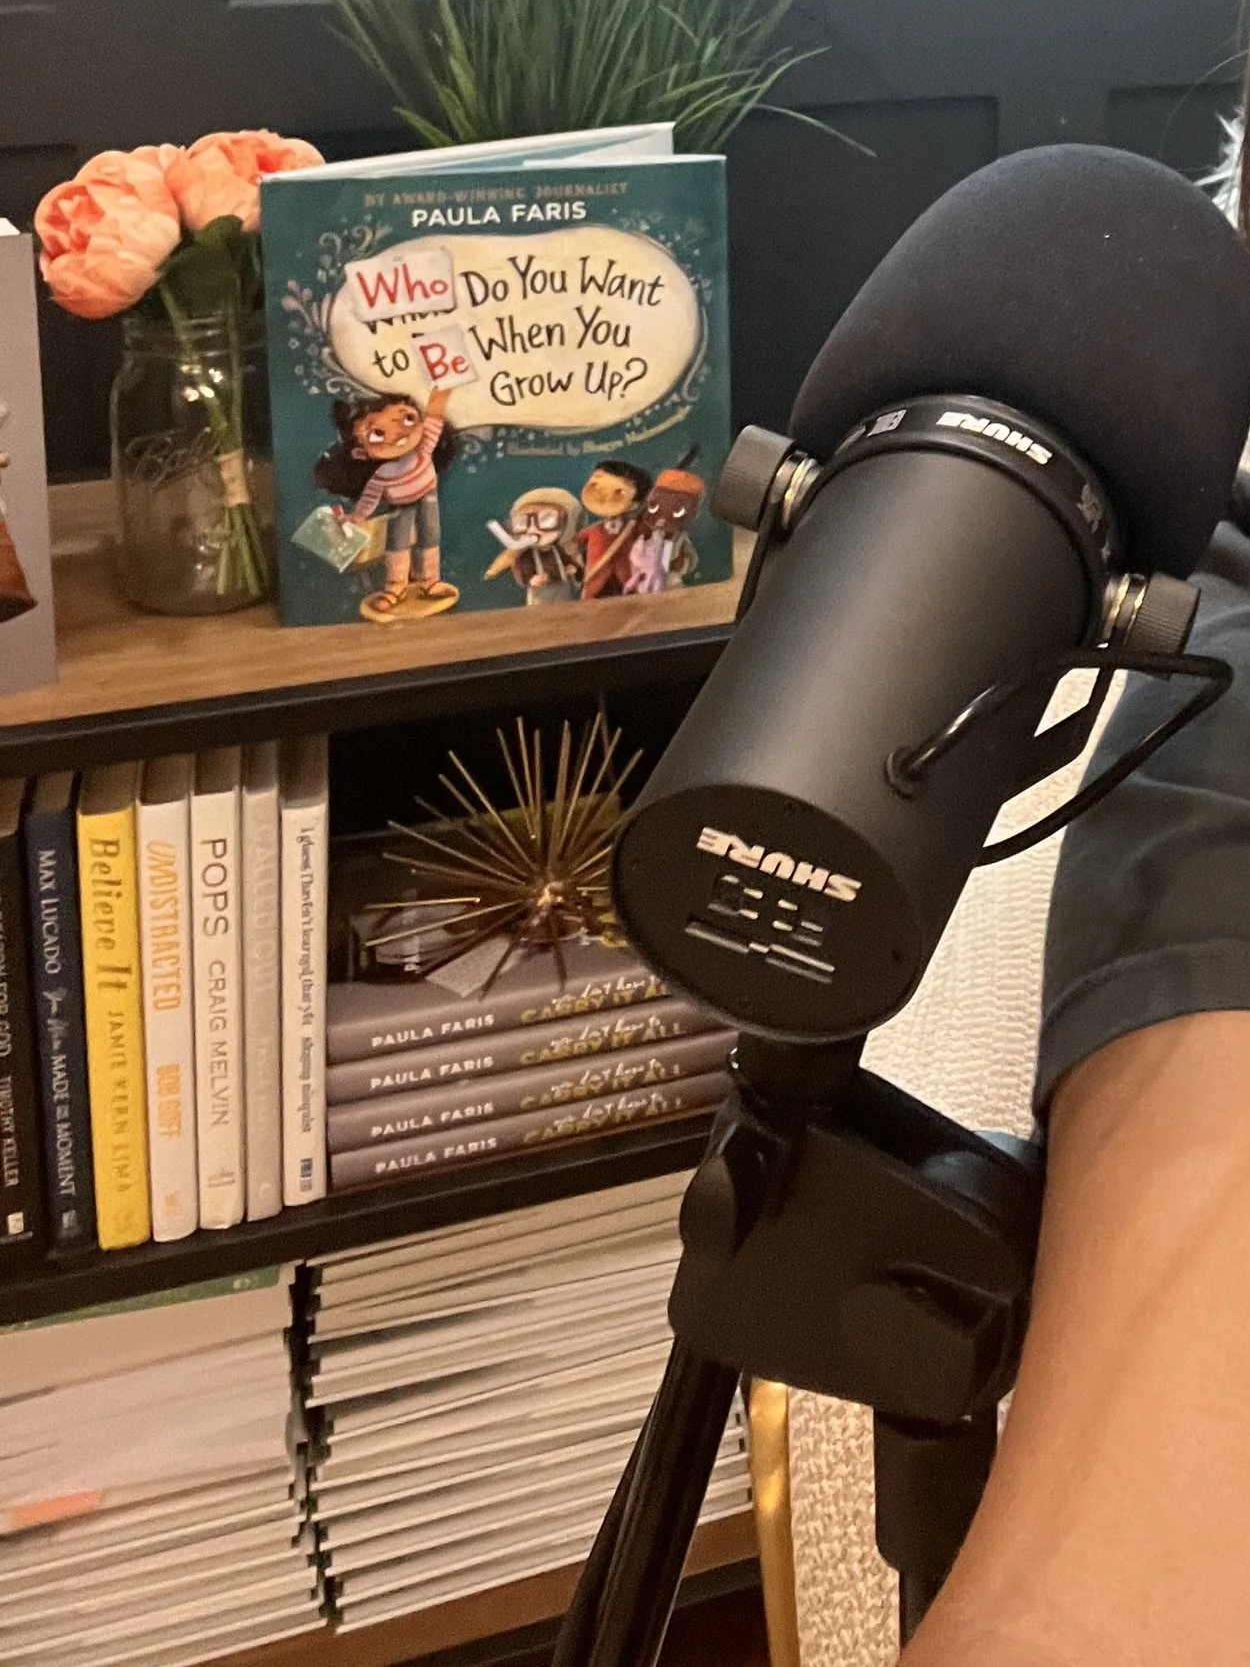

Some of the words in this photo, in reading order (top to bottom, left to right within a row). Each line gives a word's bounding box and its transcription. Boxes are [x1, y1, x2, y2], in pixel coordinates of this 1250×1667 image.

[412, 205, 501, 227] PAULA
[512, 201, 587, 222] FARIS
[356, 263, 450, 309] Who
[460, 270, 510, 307] Do
[508, 254, 568, 300] You
[579, 255, 666, 306] Want
[372, 348, 411, 379] to
[419, 341, 470, 382] Be
[468, 314, 567, 362] When
[575, 304, 632, 350] You
[489, 369, 575, 407] Grow
[584, 356, 650, 402] Up?
[935, 410, 1054, 465] SHURE
[37, 849, 58, 892] MAX
[199, 836, 228, 938] POPS
[695, 825, 863, 903] SHURE
[87, 837, 120, 952] Believe
[39, 896, 61, 974] LUCADO
[144, 840, 181, 1012] UNDISTRACTED
[95, 963, 132, 992] It
[206, 958, 226, 1033] CRAIG
[371, 1027, 433, 1047] PAULA
[441, 1014, 494, 1034] FARIS
[208, 1039, 230, 1130] MELVIN
[370, 1068, 431, 1089] PAULA
[439, 1056, 493, 1076] FARIS
[371, 1116, 432, 1137] PAULA
[441, 1102, 493, 1122] FARIS
[54, 1118, 75, 1195] MOMENT
[375, 1151, 436, 1173] PAULA
